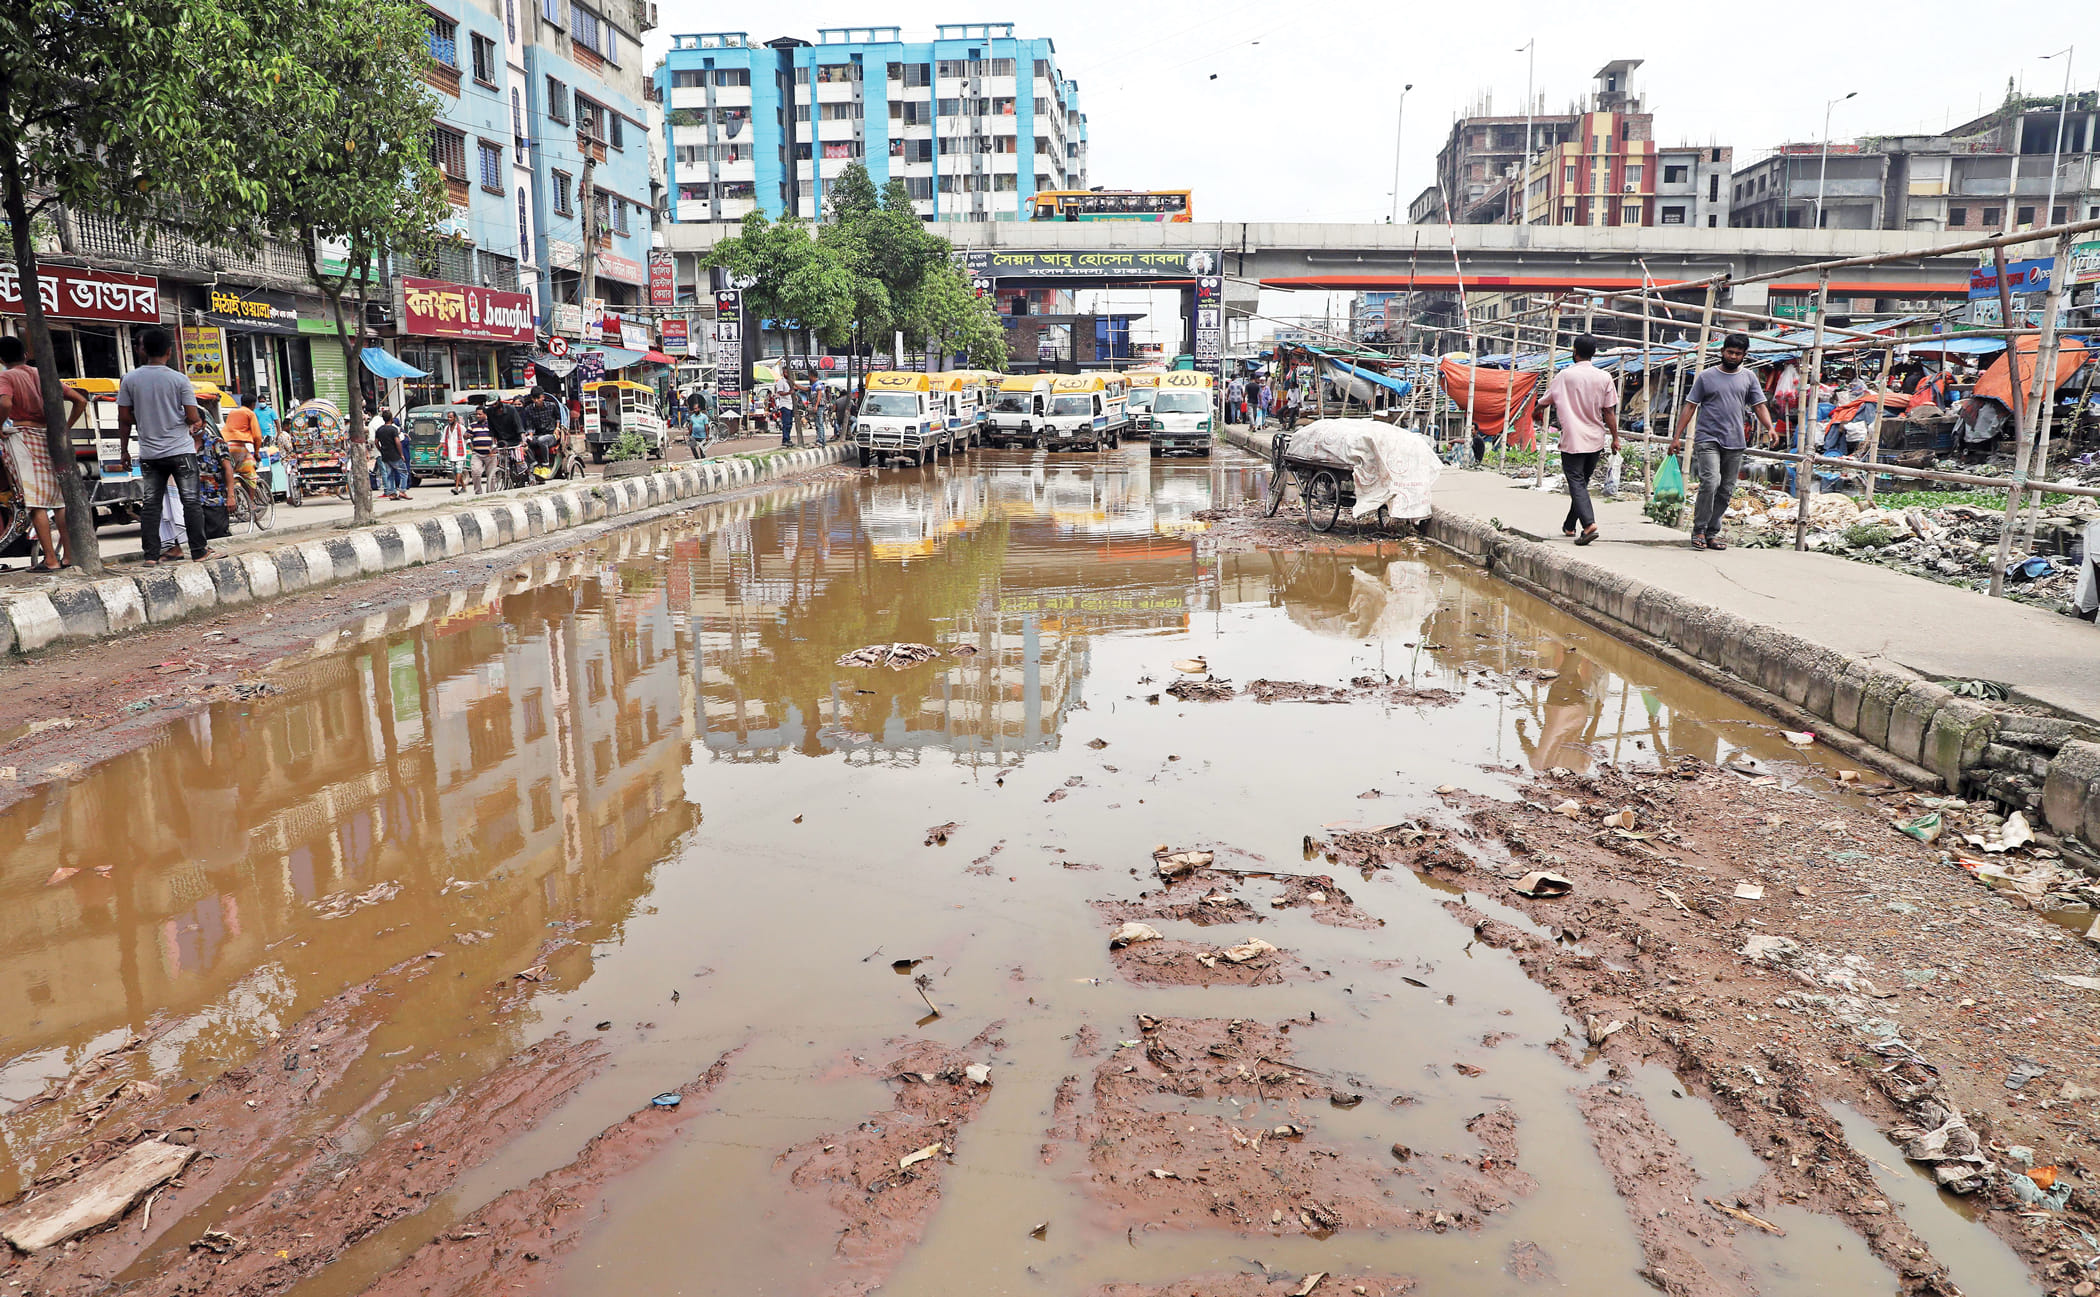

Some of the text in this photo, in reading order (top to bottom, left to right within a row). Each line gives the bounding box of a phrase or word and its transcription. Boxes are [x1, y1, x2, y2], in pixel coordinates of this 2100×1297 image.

[992, 251, 1187, 268] সৈয়দ আবু হোসেন বাবলা
[211, 290, 241, 318] মিঠাই
[404, 287, 467, 324] বনফুল
